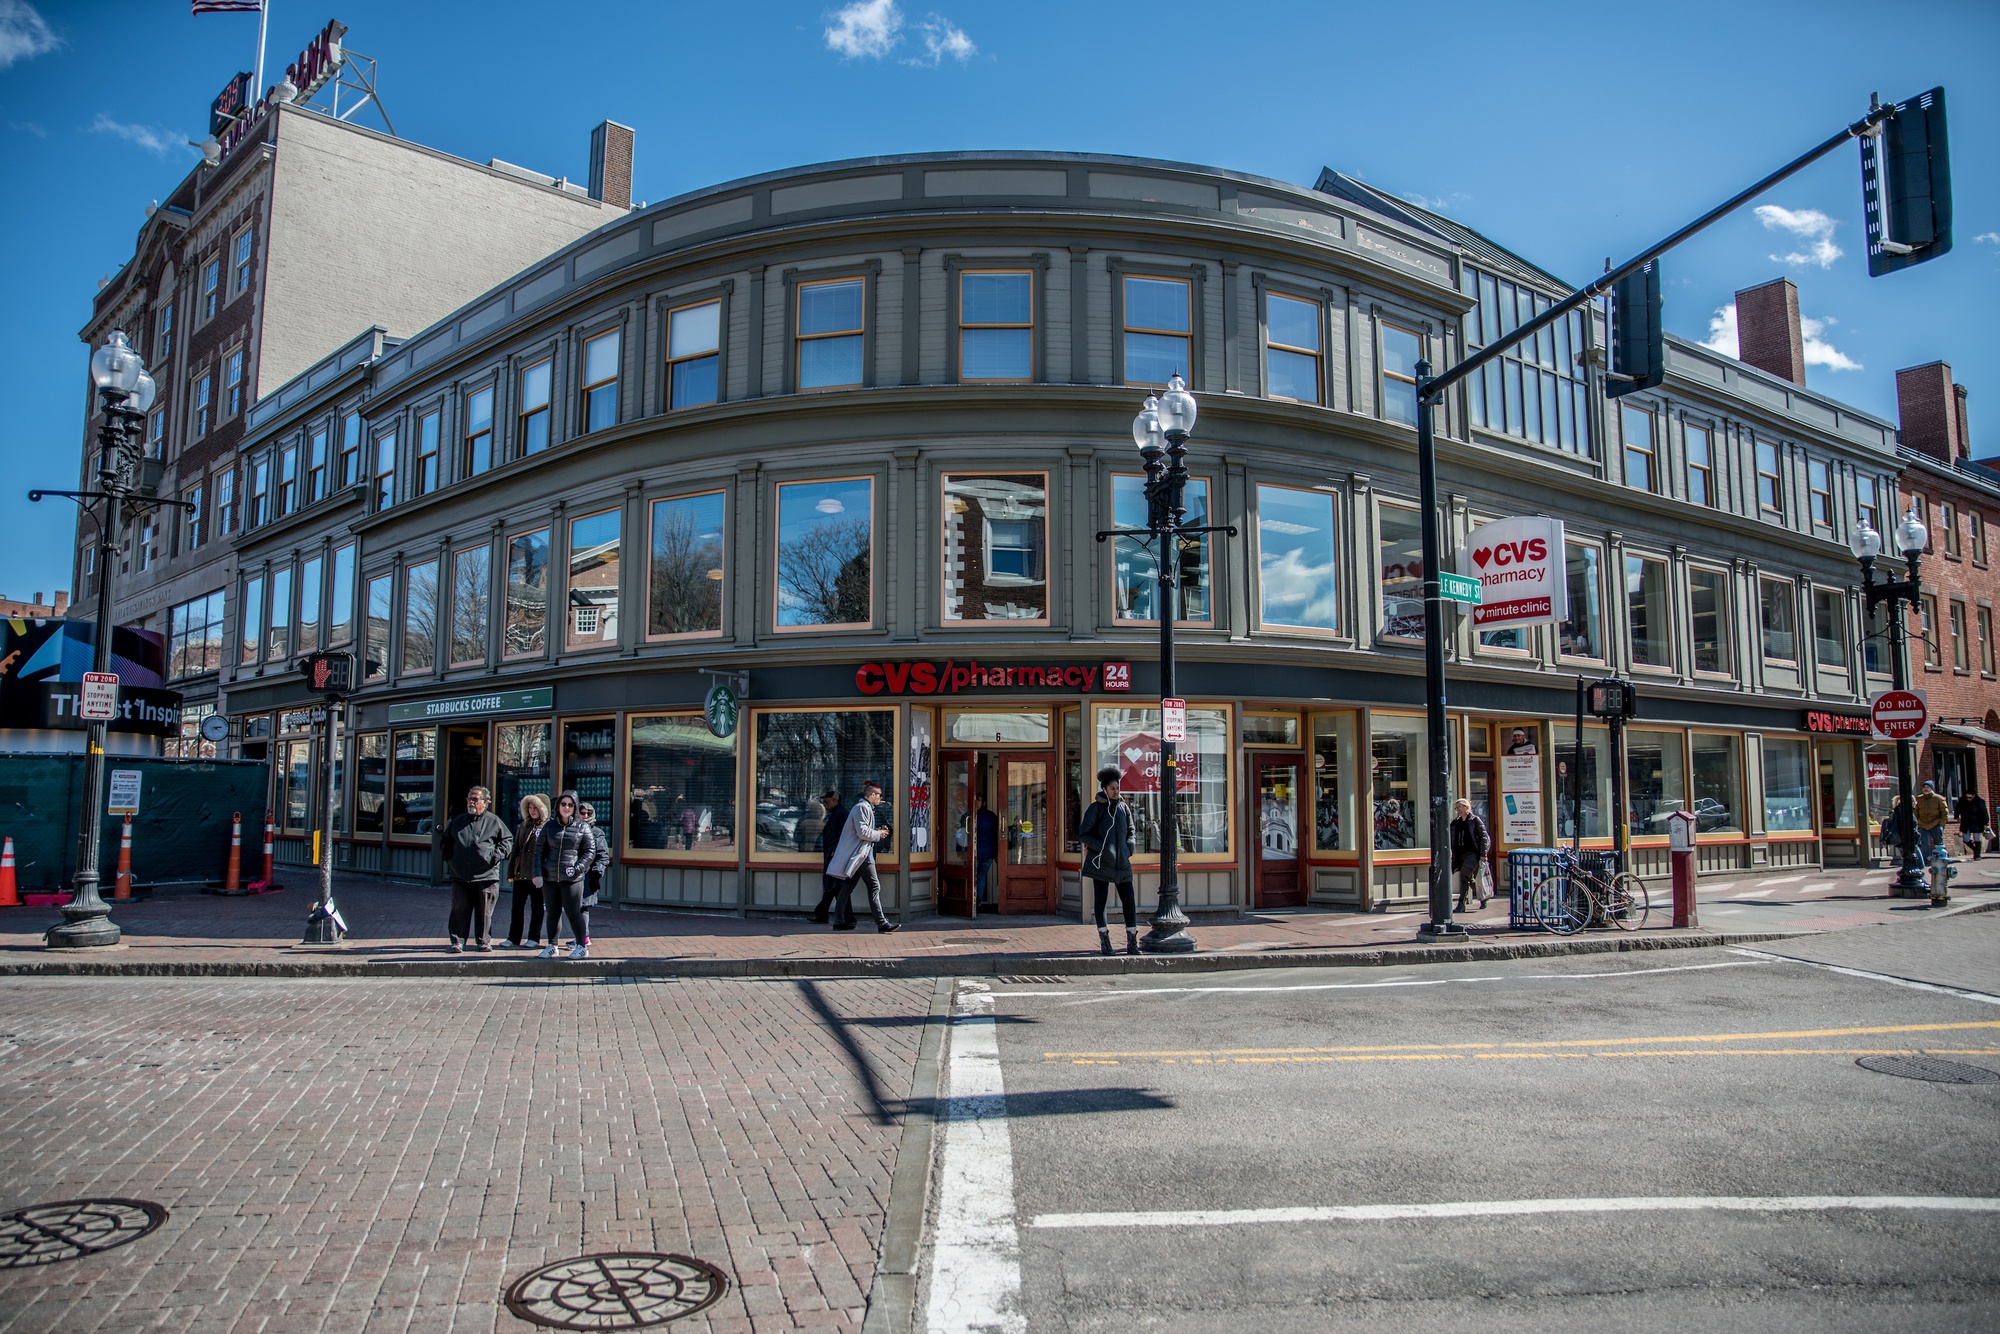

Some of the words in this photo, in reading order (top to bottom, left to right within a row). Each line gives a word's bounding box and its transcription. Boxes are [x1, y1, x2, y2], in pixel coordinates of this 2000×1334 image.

[1493, 538, 1547, 566] CVS
[1477, 567, 1545, 587] pharmacy
[1450, 580, 1472, 597] KENNEDY
[1486, 603, 1519, 618] minute
[1520, 600, 1549, 613] clinic
[101, 675, 116, 683] ZONE
[856, 661, 1097, 694] CVS/pharmacy
[1106, 665, 1129, 680] 24
[87, 692, 114, 700] STOPPING
[51, 694, 81, 716] Th
[426, 699, 470, 715] STARBUCKS
[471, 696, 501, 711] COFFEE
[1879, 701, 1893, 709] DO
[1898, 700, 1917, 708] NOT
[1884, 721, 1915, 730] ENTER
[995, 732, 1001, 742] 6
[1145, 748, 1194, 762] miute
[1145, 764, 1182, 777] clic
[1873, 762, 1888, 771] minute
